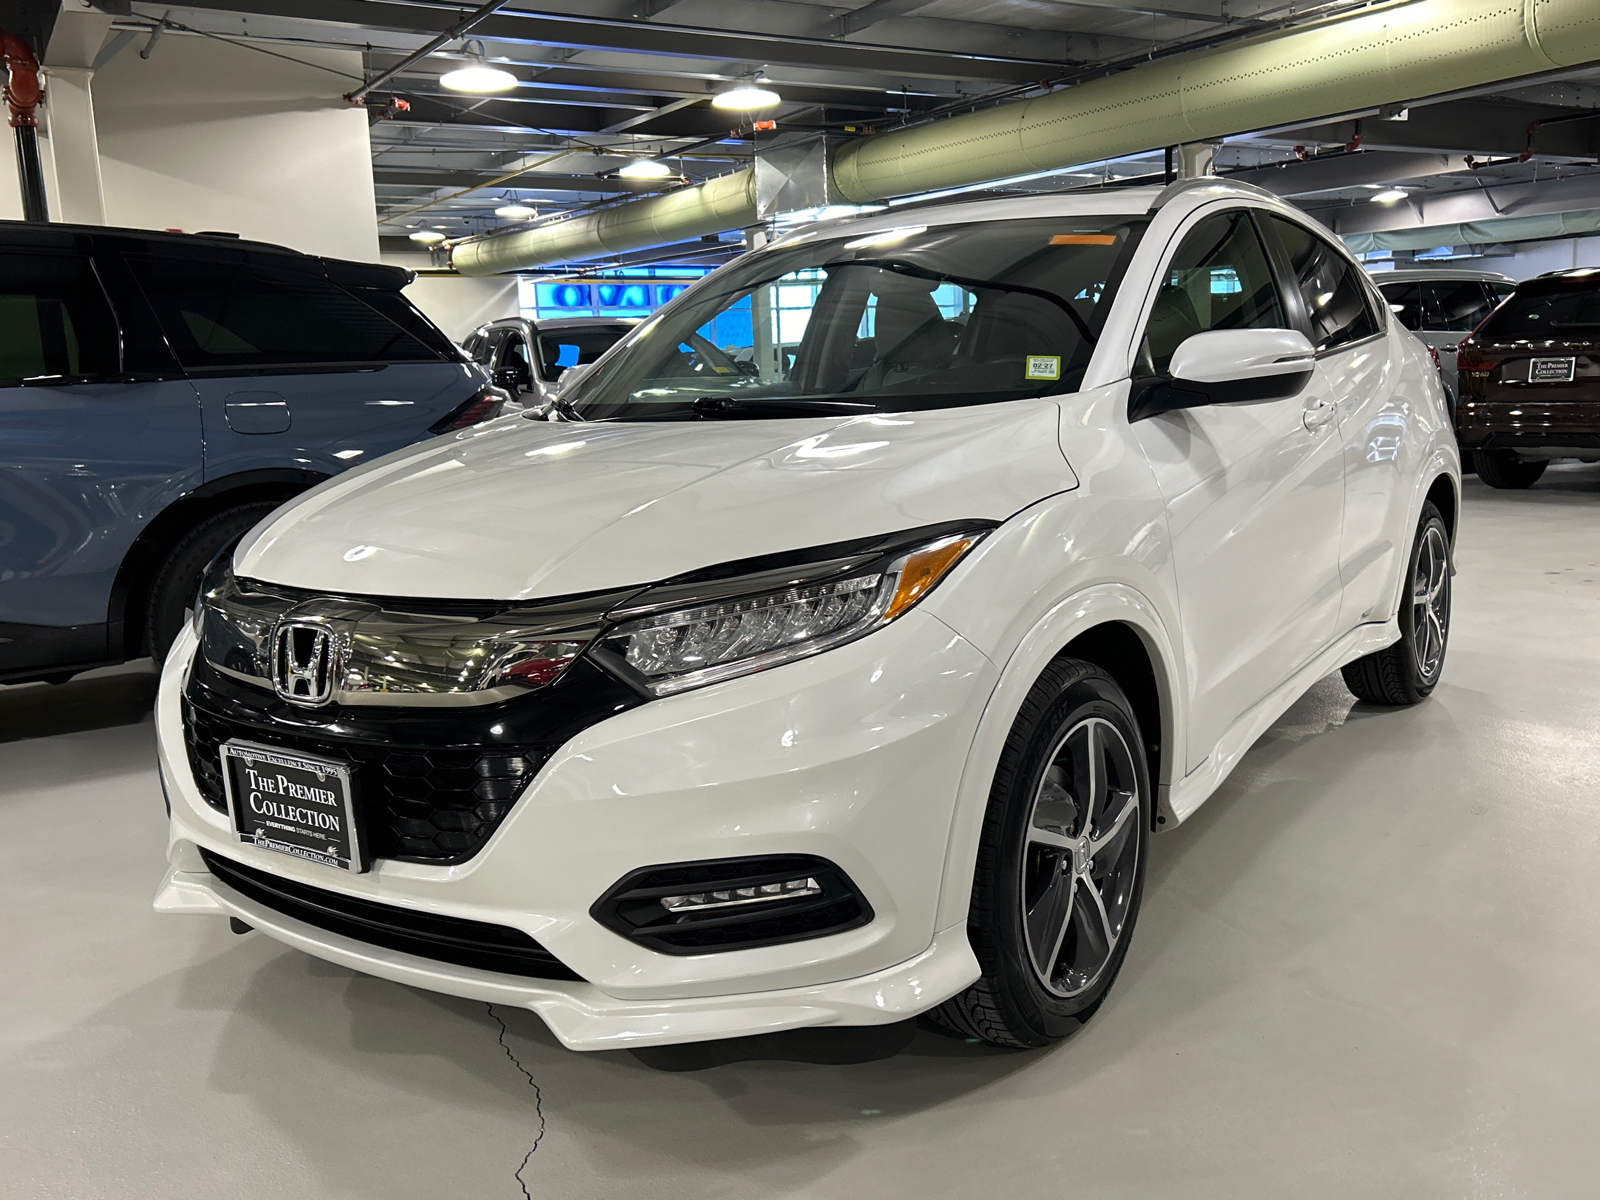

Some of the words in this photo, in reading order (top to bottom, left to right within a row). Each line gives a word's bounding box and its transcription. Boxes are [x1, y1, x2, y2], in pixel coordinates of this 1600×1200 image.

[249, 792, 340, 832] COLLECTION
[266, 820, 296, 833] EVERYTHING
[296, 827, 313, 837] STARTS
